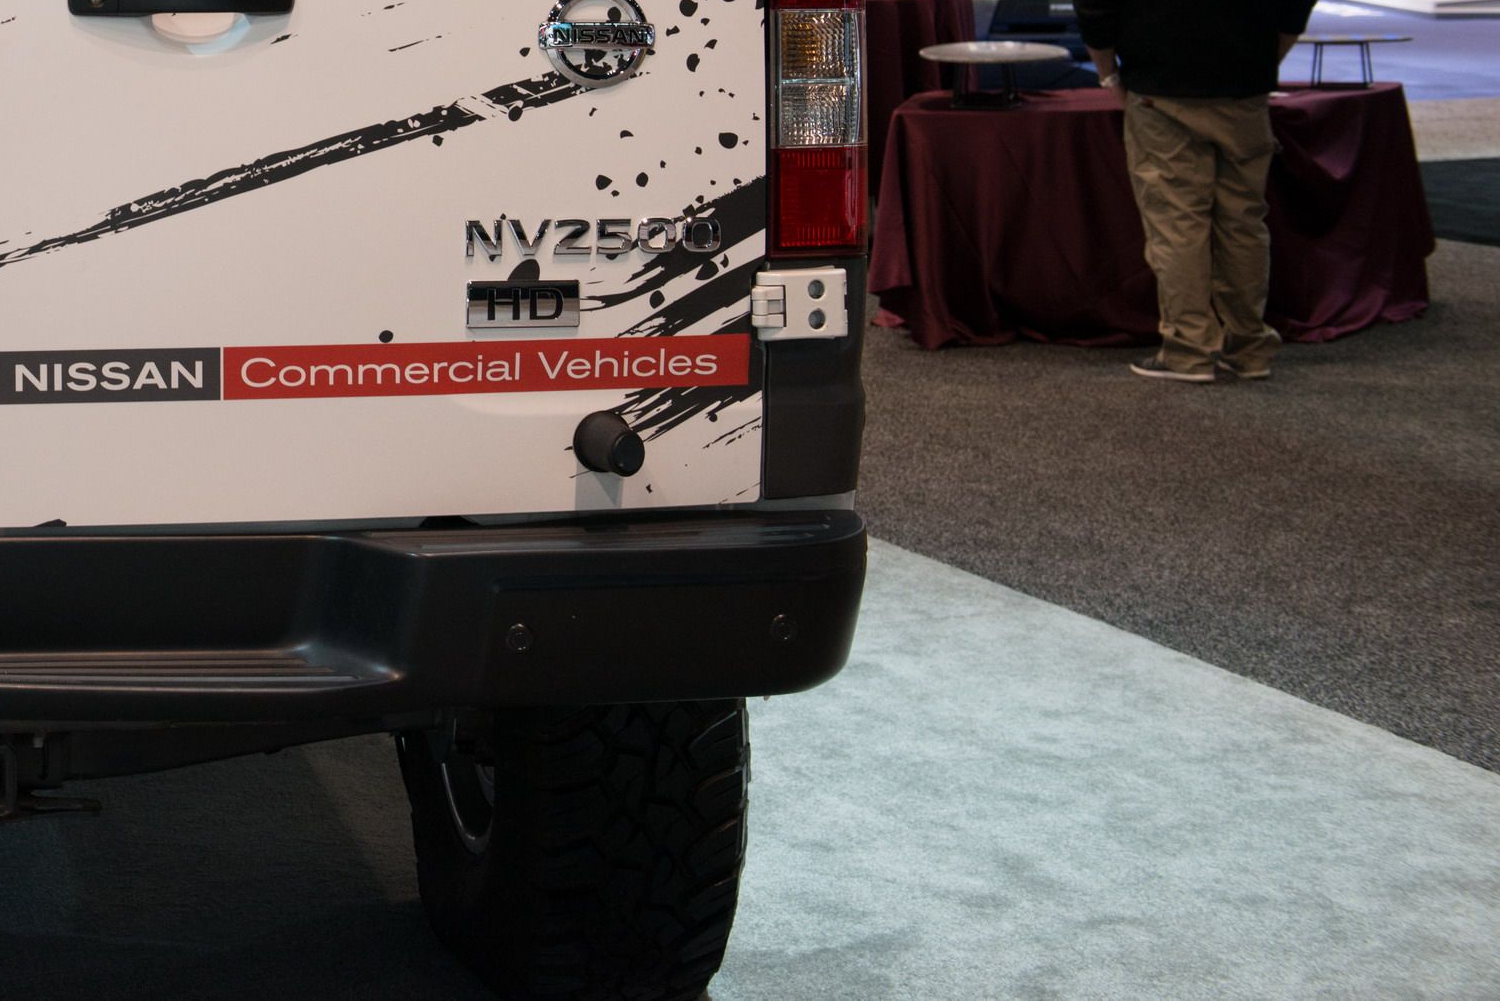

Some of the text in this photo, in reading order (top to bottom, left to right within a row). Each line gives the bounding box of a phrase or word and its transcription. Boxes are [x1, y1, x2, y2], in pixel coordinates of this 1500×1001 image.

[553, 27, 645, 45] NISSAN
[466, 217, 722, 257] NV2500
[486, 286, 565, 321] HD
[14, 347, 718, 392] NISSAN Commercial Vehicles
